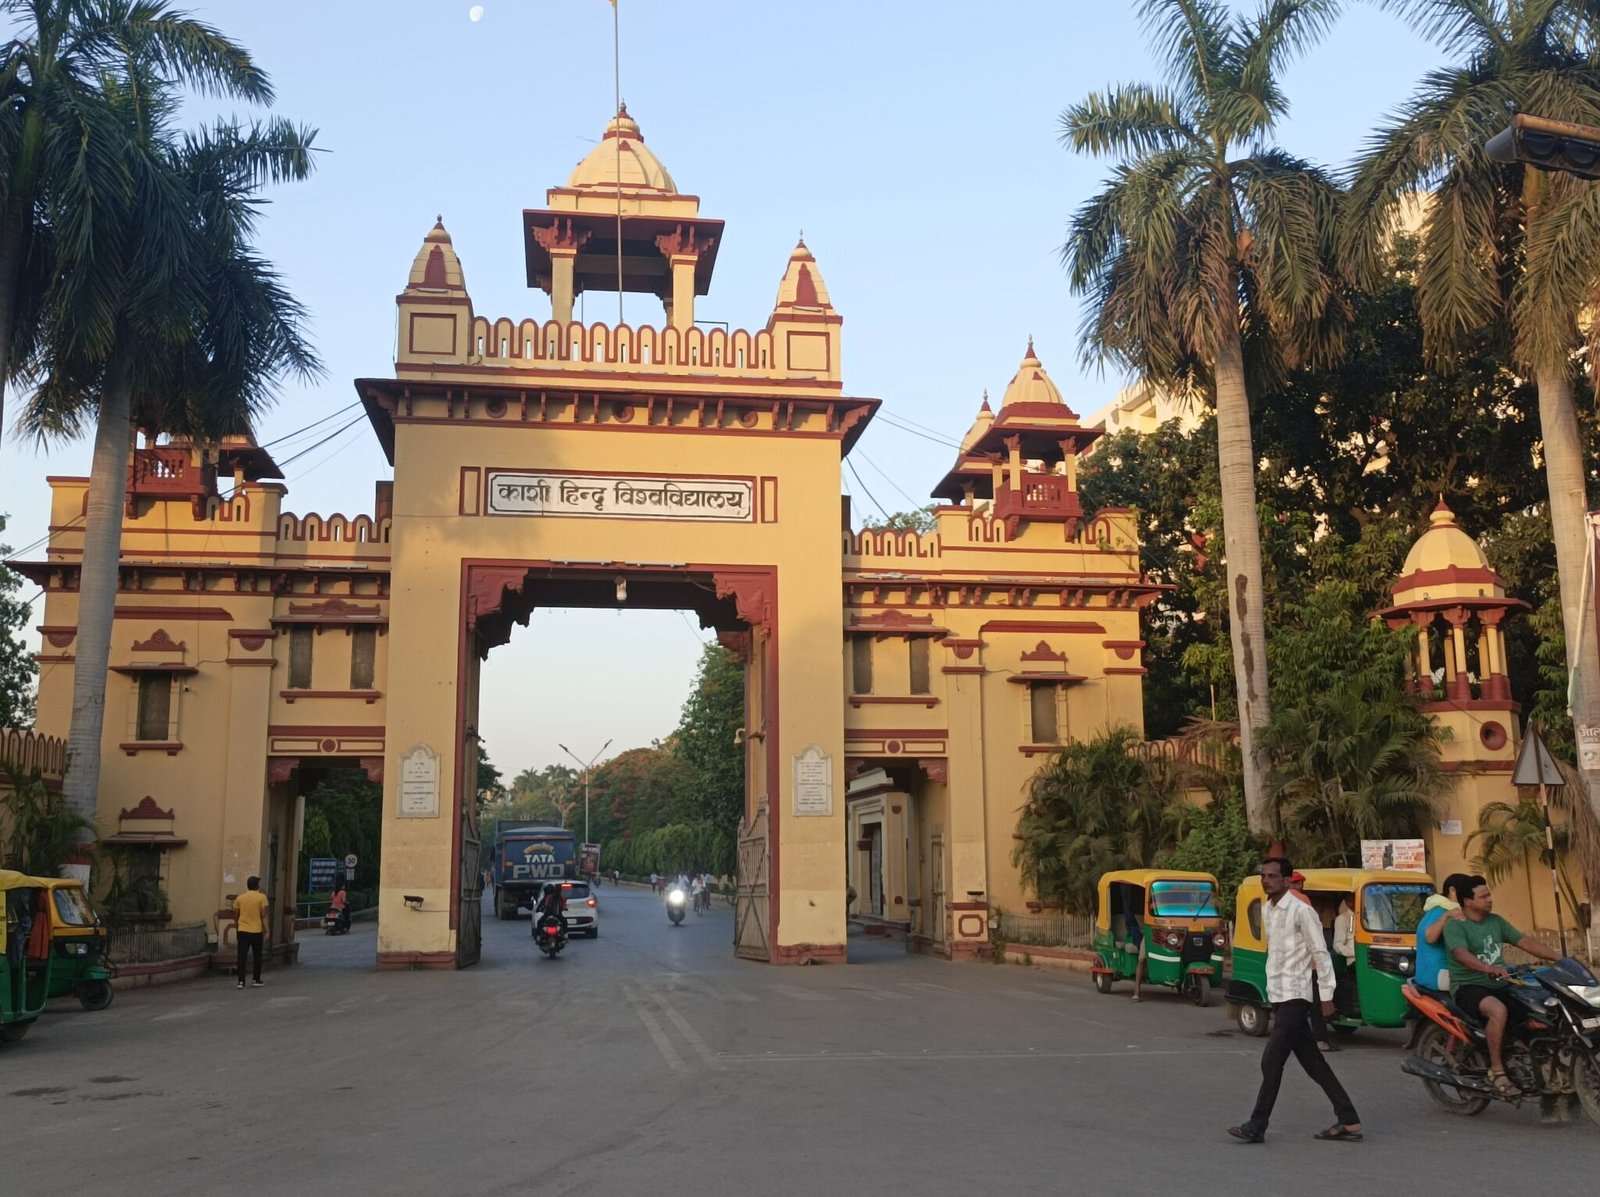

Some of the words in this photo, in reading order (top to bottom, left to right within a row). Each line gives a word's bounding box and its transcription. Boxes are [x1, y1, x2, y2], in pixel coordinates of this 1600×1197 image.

[497, 479, 550, 502] काशी
[559, 480, 607, 511] हिन्दू
[613, 481, 744, 509] विश्वविद्यालय
[524, 854, 555, 863] TATA
[512, 864, 565, 878] PWD
